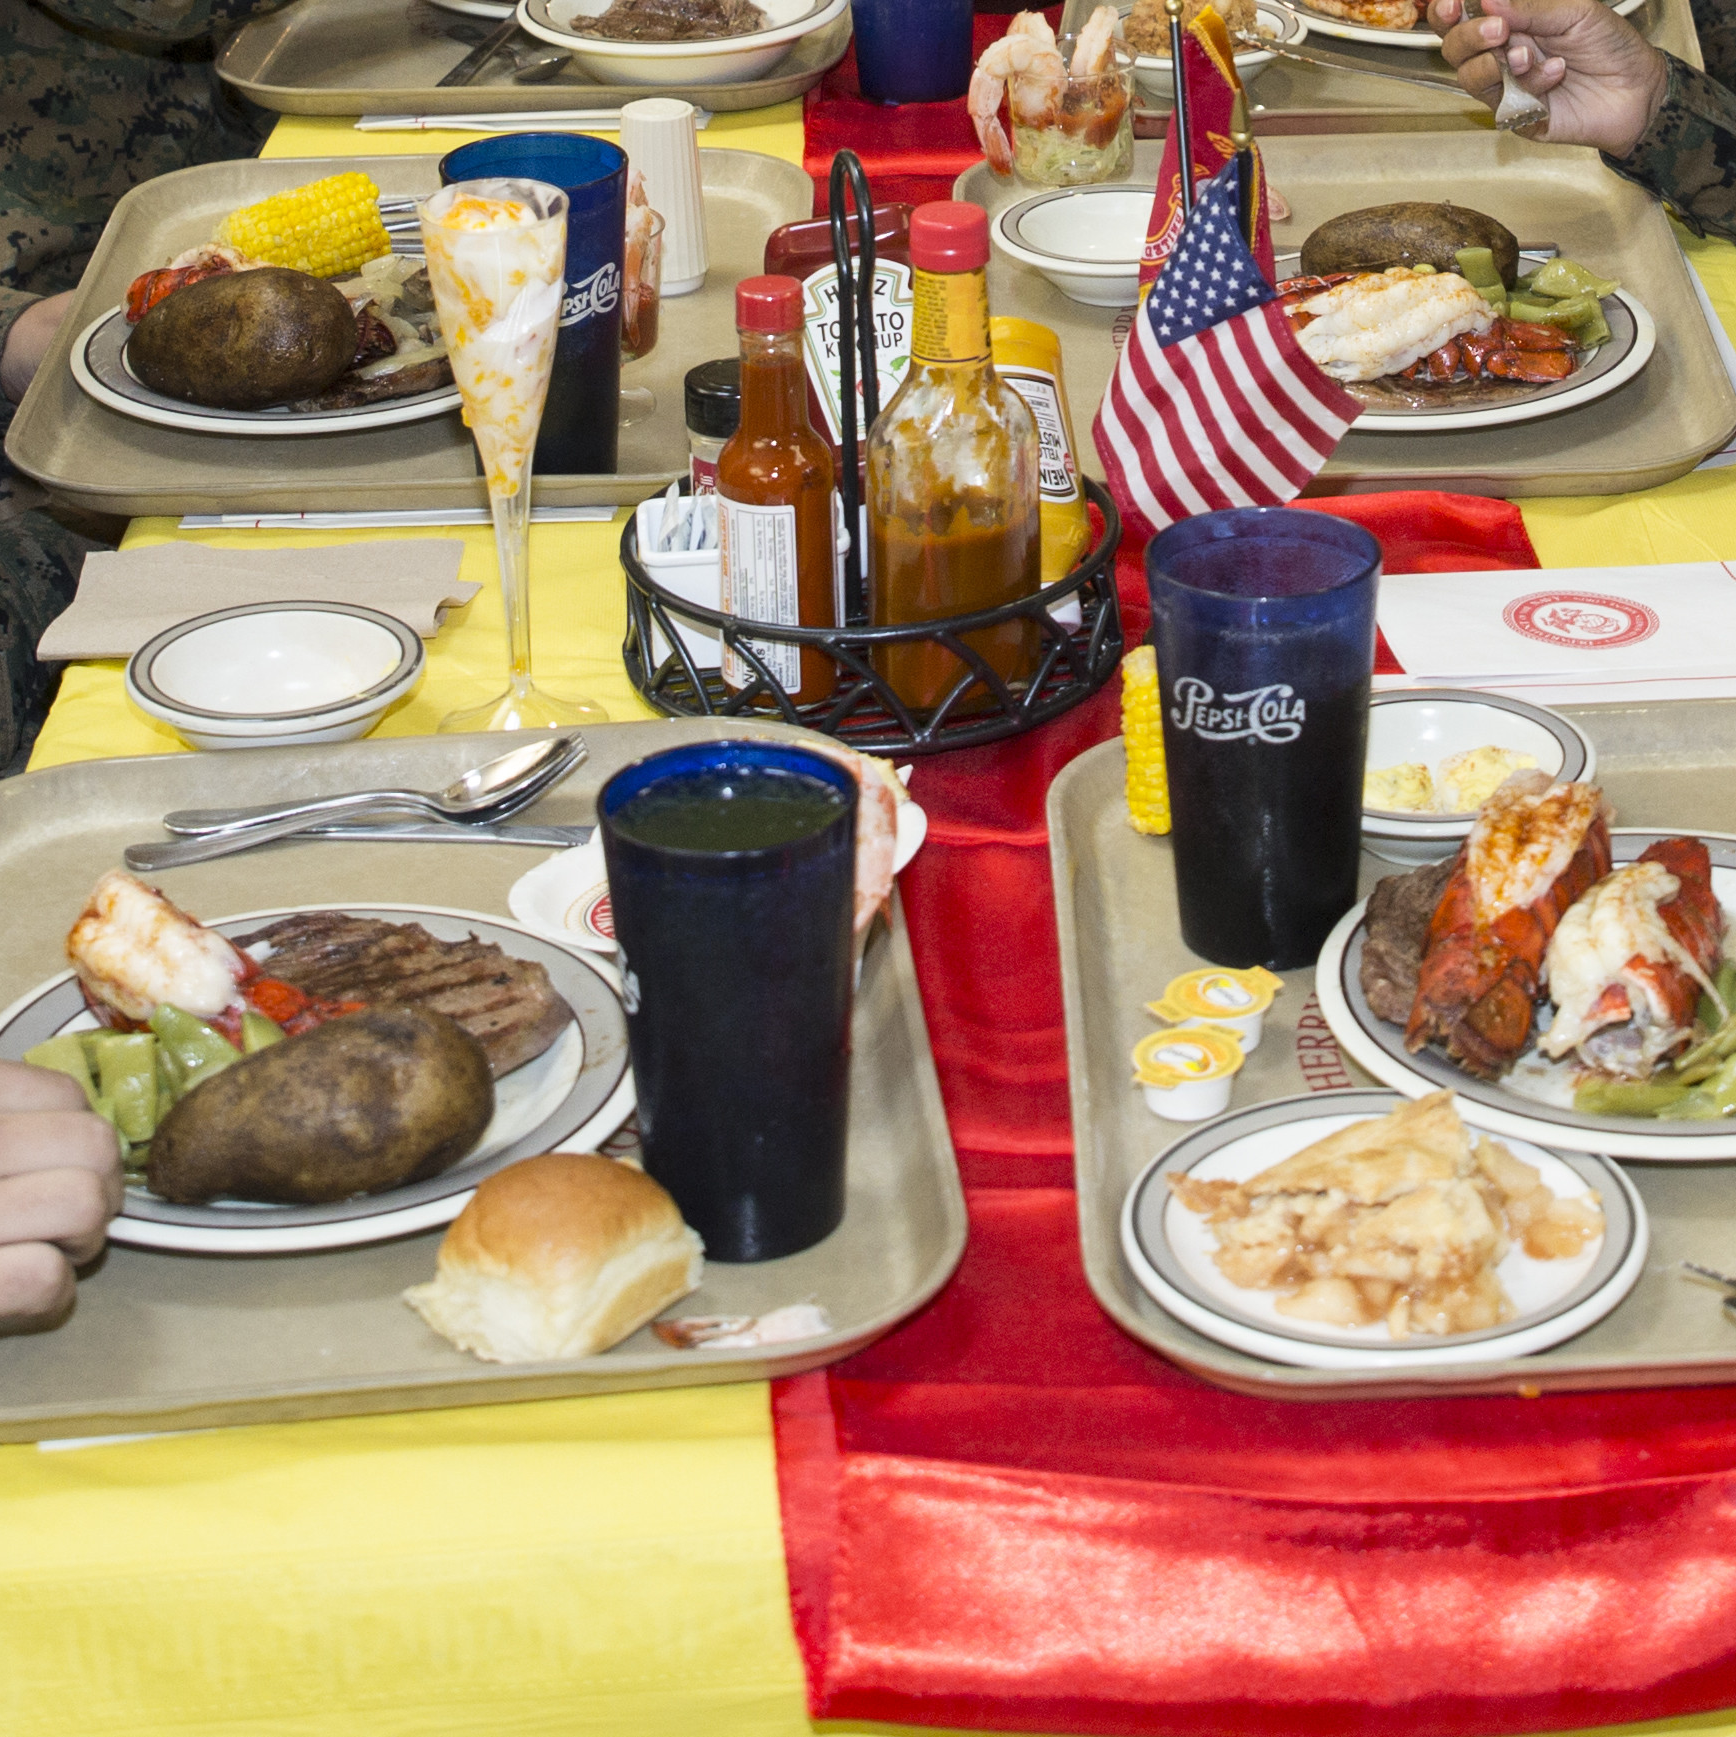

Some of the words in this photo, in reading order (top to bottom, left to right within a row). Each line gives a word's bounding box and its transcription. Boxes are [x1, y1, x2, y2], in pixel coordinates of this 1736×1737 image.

[561, 262, 621, 328] PSI-COLA
[1039, 468, 1068, 486] HEIN
[1170, 676, 1306, 744] PEPSI-COLA
